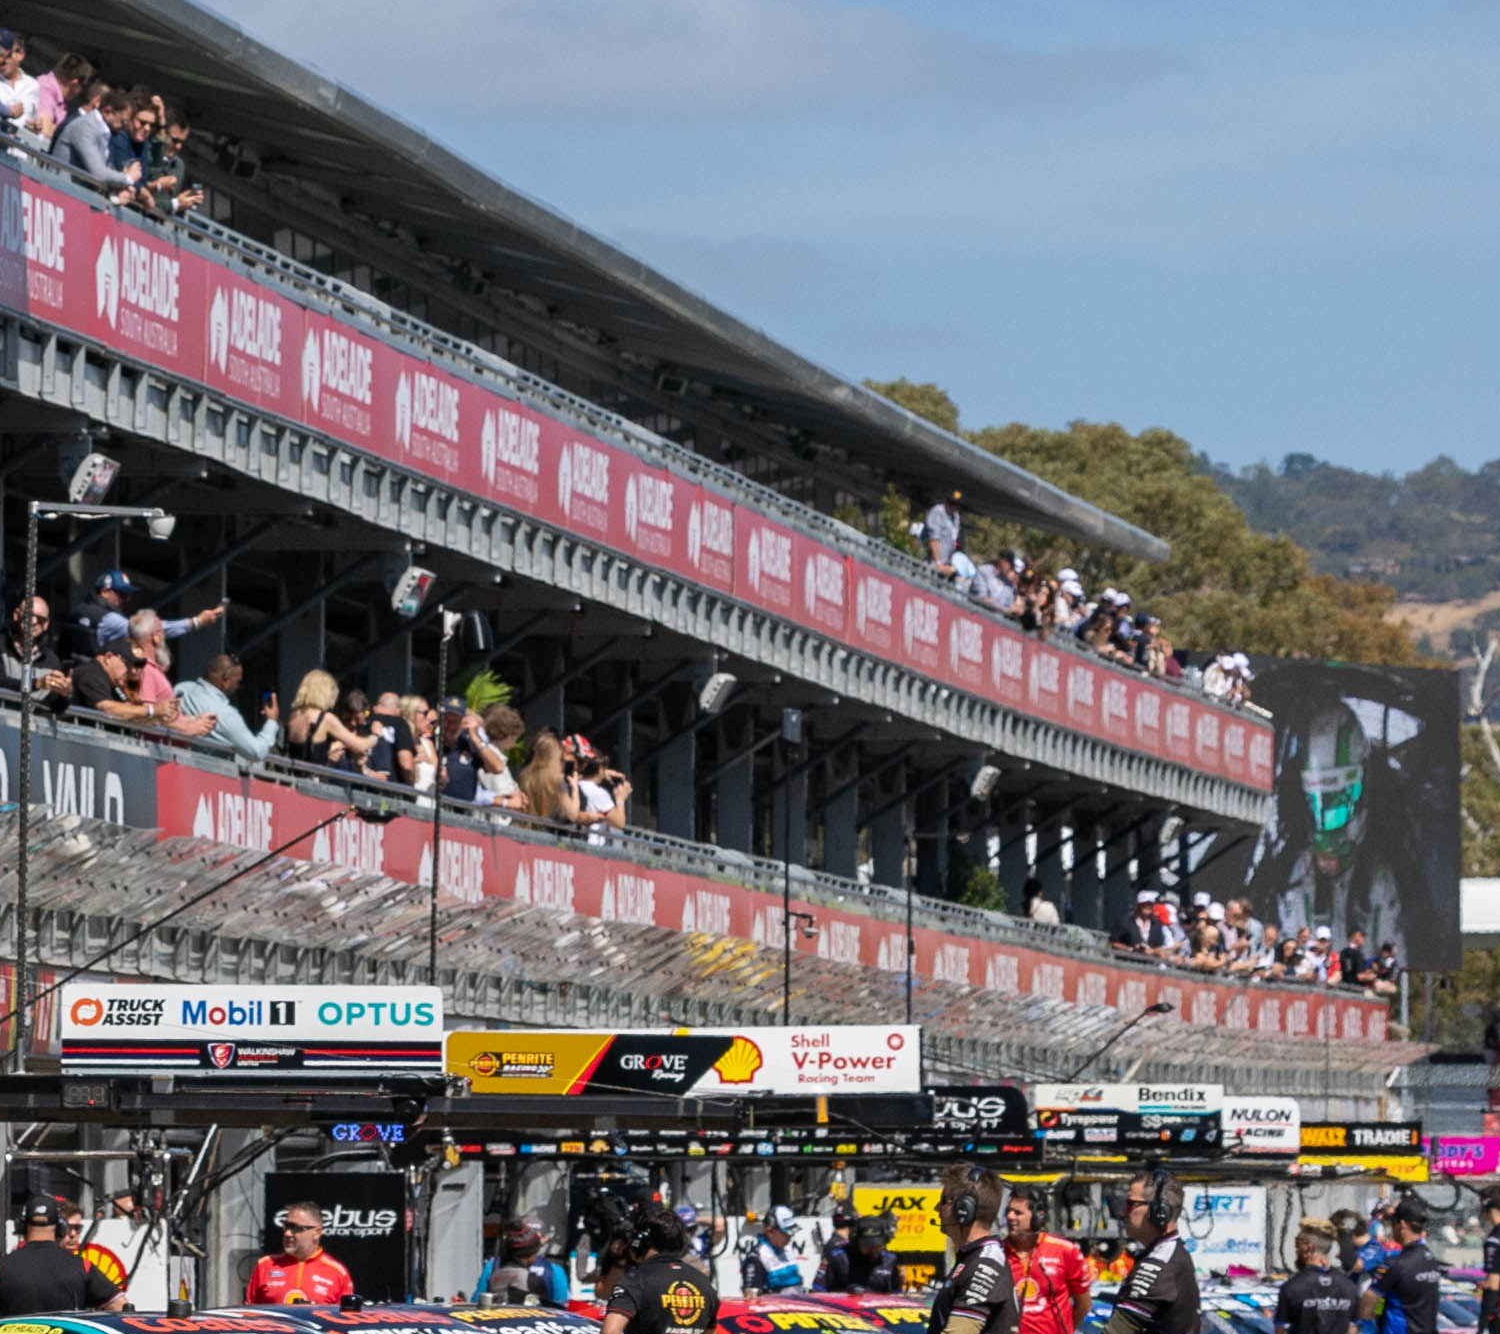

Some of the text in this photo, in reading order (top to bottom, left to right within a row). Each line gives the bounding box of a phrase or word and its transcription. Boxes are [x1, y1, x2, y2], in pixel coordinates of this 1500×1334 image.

[0, 176, 65, 272] ADELAIDE
[120, 238, 180, 323] ADELAIDE
[230, 286, 281, 366] ADELAIDE
[322, 328, 373, 406] ADELAIDE
[411, 369, 460, 443] ADELAIDE
[497, 408, 540, 479] ADELAIDE
[571, 443, 610, 509] ADELAIDE
[44, 759, 124, 826] VAILO
[217, 791, 273, 853] ADELAIDE
[331, 816, 385, 876] ADELAIDE
[439, 839, 484, 903] ADELAIDE
[533, 856, 575, 913] ADELAIDE
[106, 999, 167, 1013] TRUCK
[181, 1000, 295, 1026] Mobil 1
[318, 1002, 435, 1026] OPTUS
[102, 1012, 163, 1026] ASSIST
[238, 1047, 296, 1057] WALKINSHAW
[791, 1033, 830, 1049] Shell
[502, 1053, 554, 1065] PENRITE
[620, 1054, 687, 1069] GROVE
[793, 1052, 897, 1071] V-Power
[652, 1070, 685, 1083] Racing
[798, 1073, 876, 1085] Racing Team
[1138, 1086, 1206, 1102] Bendix
[1231, 1107, 1293, 1124] NULON
[332, 1122, 404, 1142] GROVE
[873, 1196, 927, 1211] JAX
